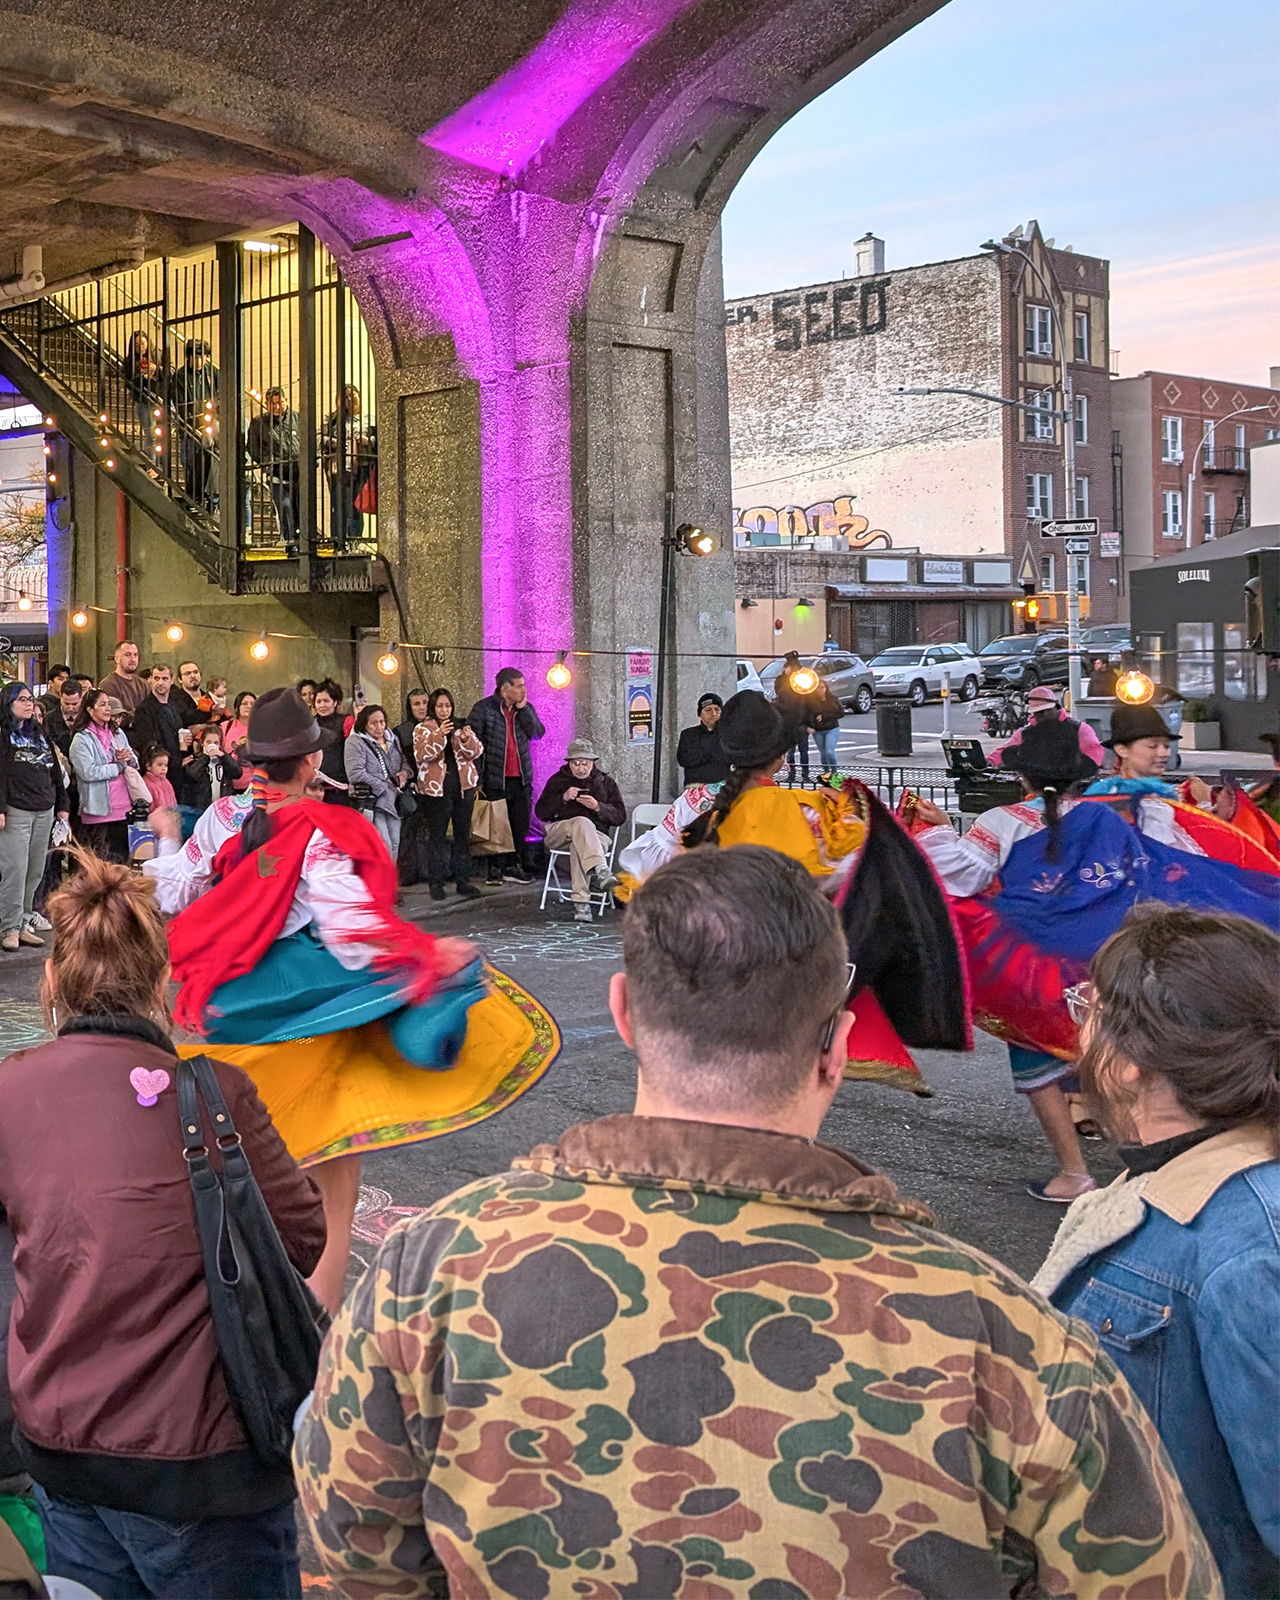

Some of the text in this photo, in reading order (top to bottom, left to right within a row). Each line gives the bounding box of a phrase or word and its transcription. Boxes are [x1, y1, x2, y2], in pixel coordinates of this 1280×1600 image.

[1048, 523, 1093, 533] ONE WAY
[1177, 569, 1210, 584] SOLELUNA
[425, 649, 445, 663] 178
